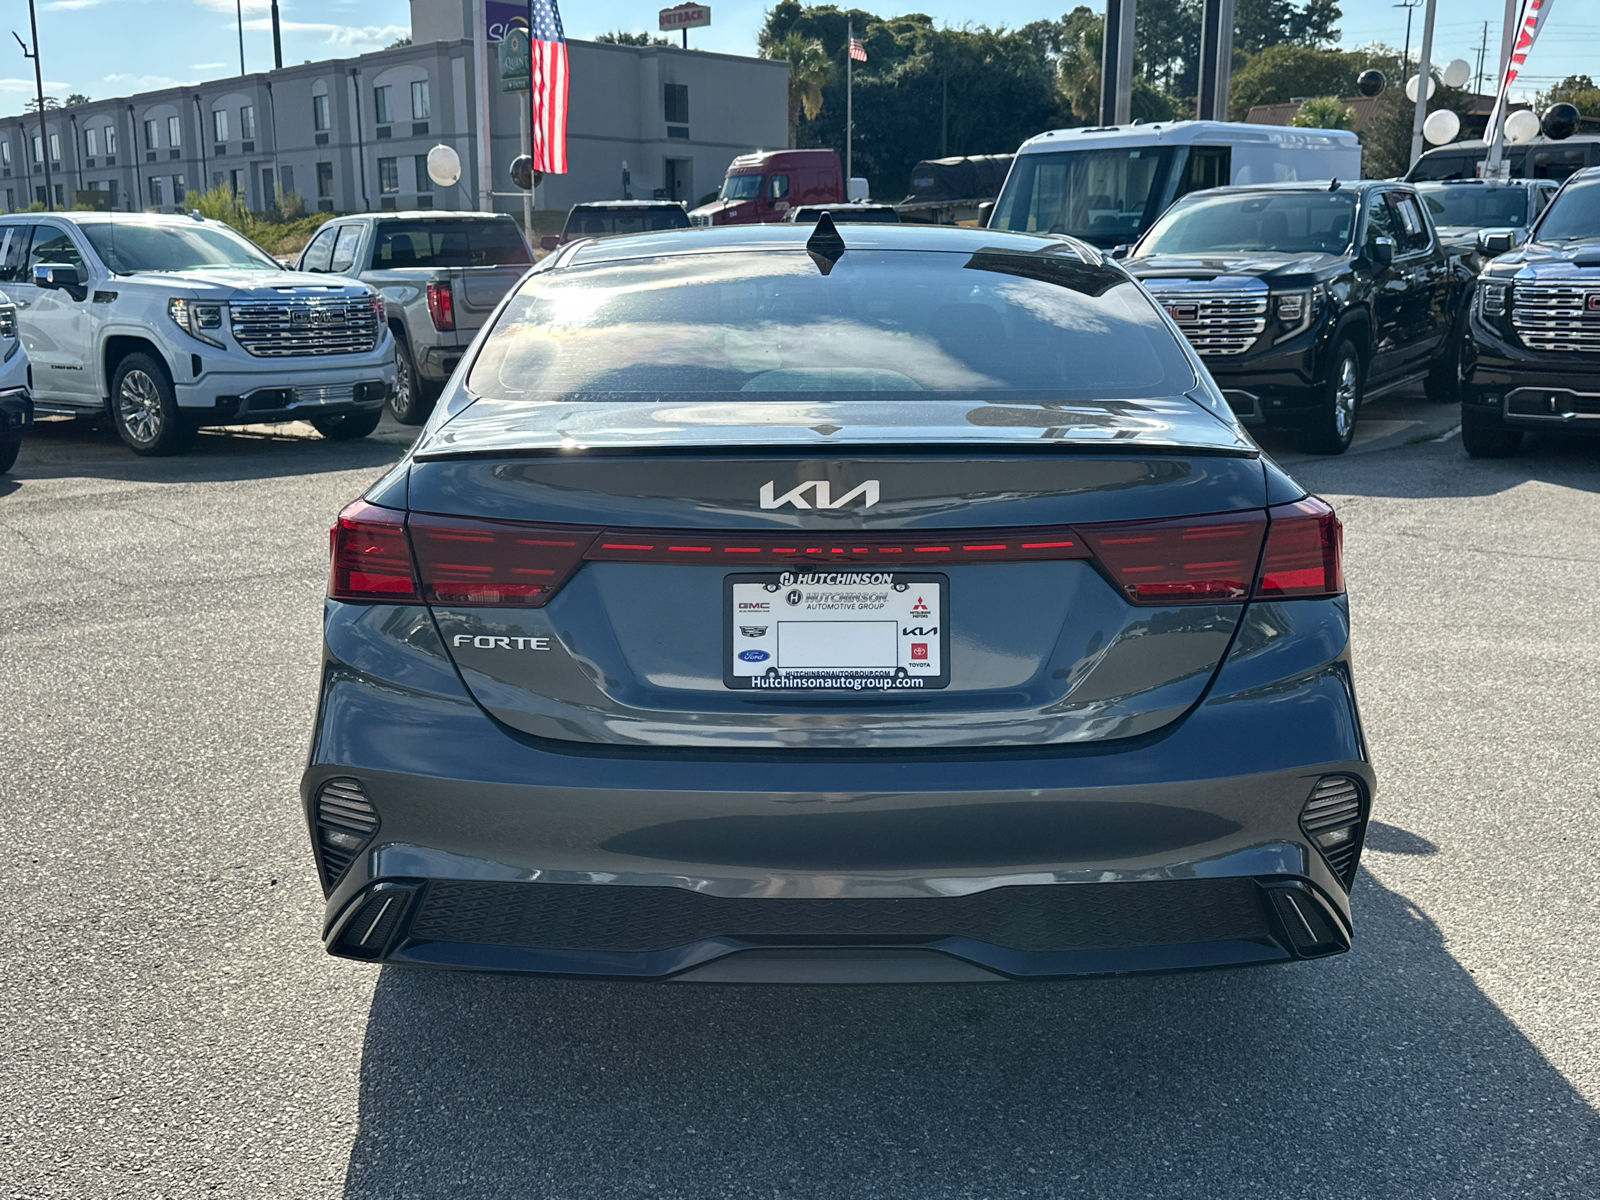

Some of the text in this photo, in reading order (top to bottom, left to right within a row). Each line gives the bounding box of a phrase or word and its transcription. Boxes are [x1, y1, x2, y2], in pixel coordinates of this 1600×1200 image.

[292, 309, 345, 323] GMC
[759, 479, 880, 510] KIA
[796, 573, 894, 586] HUTCHINSON
[804, 592, 888, 603] HUTCHINSON
[902, 627, 938, 636] KIA
[453, 634, 551, 651] FORTE
[744, 651, 764, 660] Ford
[751, 675, 924, 690] Hutchinsonautogroup.com
